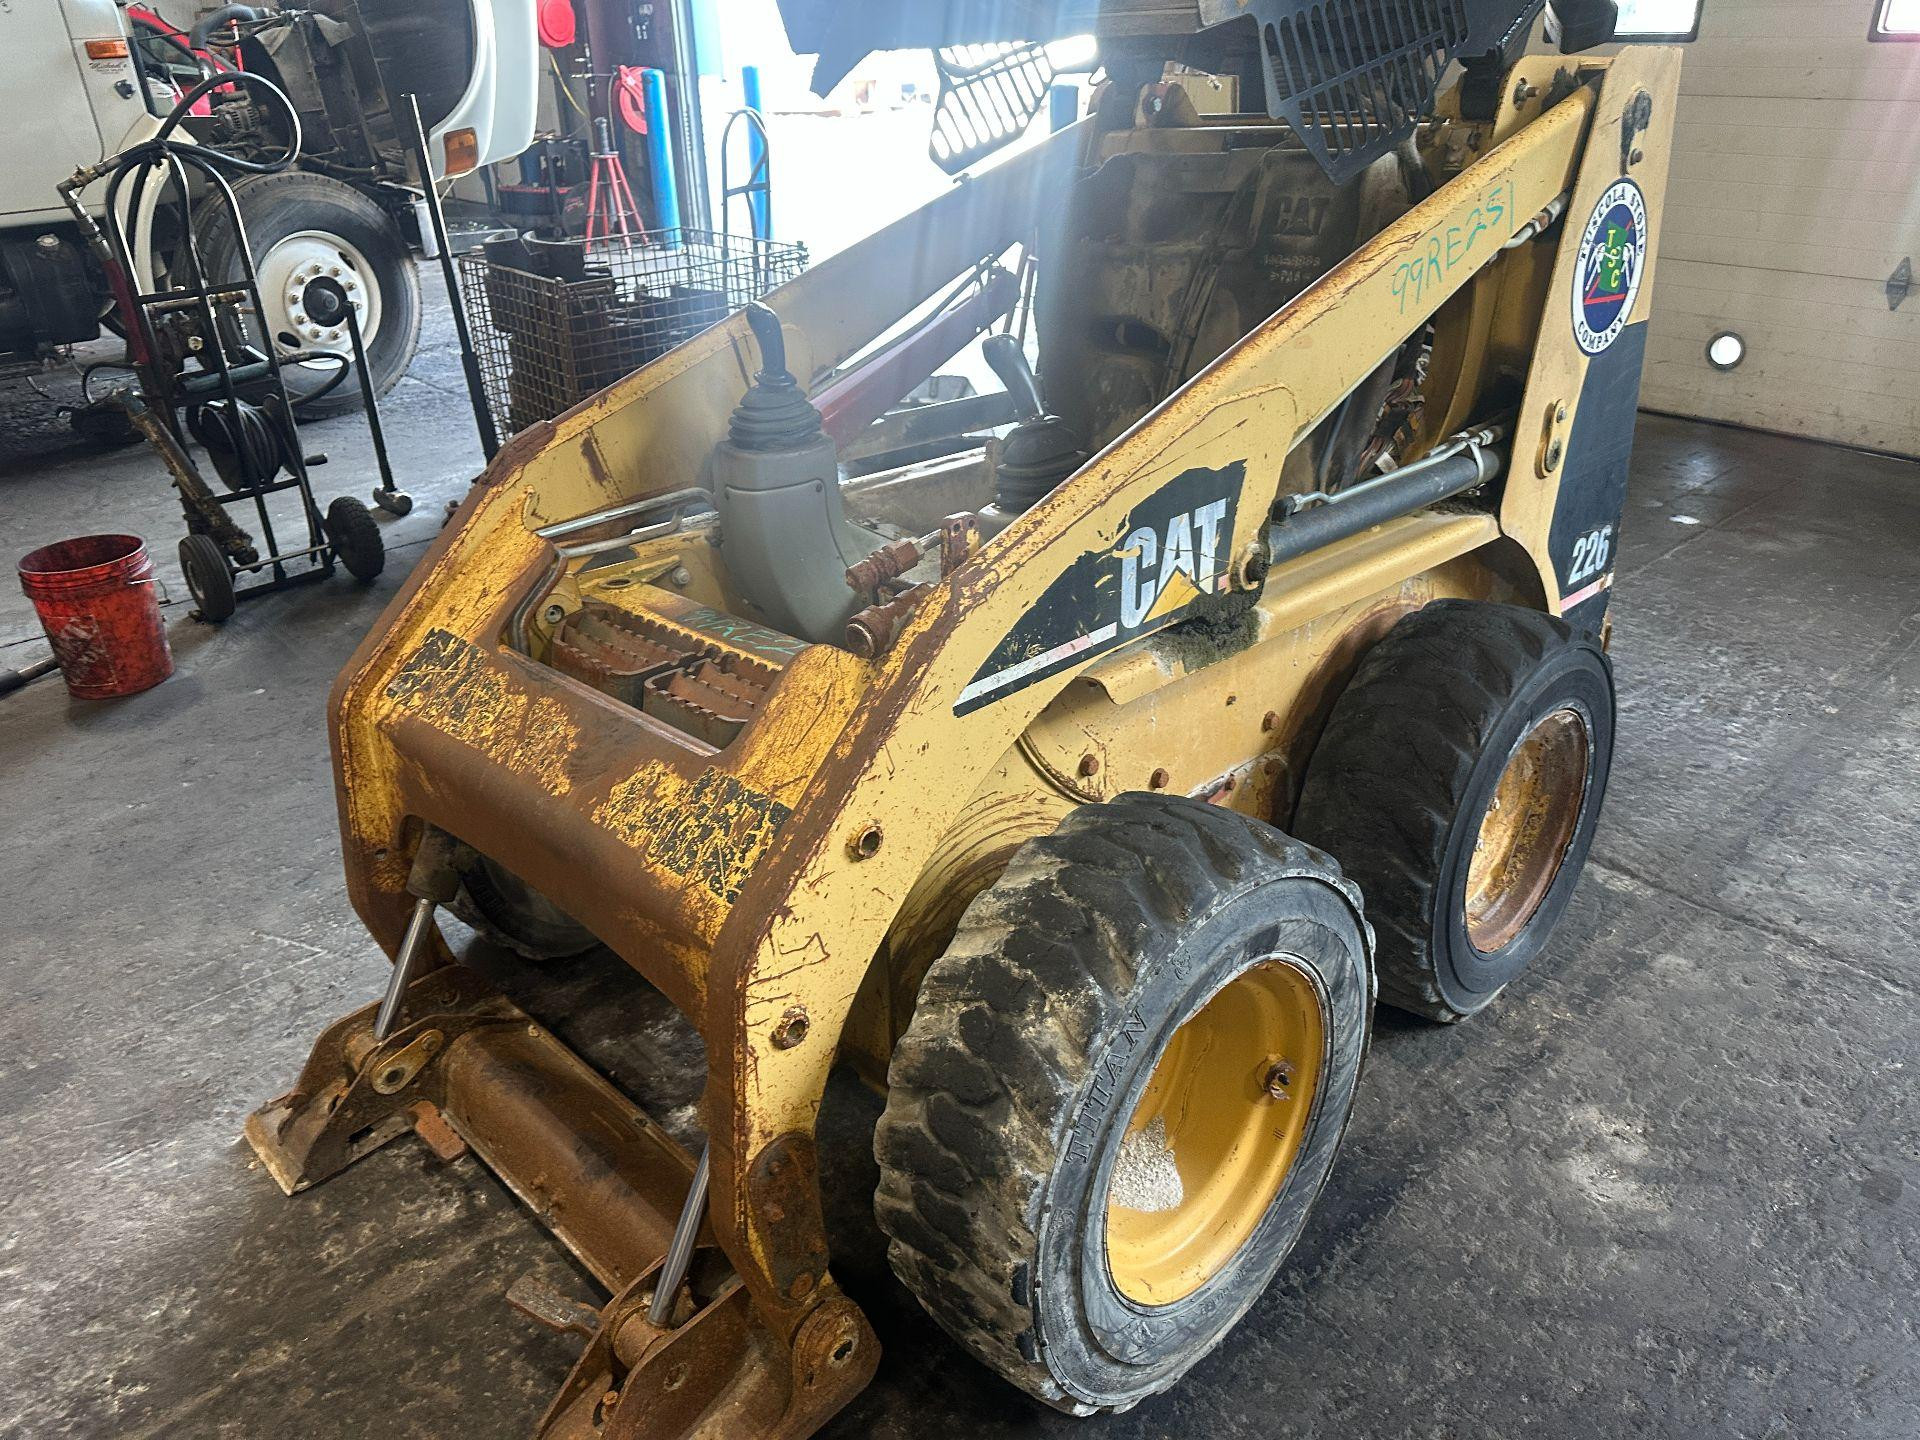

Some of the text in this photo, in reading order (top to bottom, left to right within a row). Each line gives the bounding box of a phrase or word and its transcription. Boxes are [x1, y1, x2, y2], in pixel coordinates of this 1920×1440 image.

[1577, 311, 1624, 350] COMPANY
[1120, 497, 1227, 629] CAT
[1567, 524, 1613, 586] 226
[1065, 1003, 1148, 1164] TITAN
